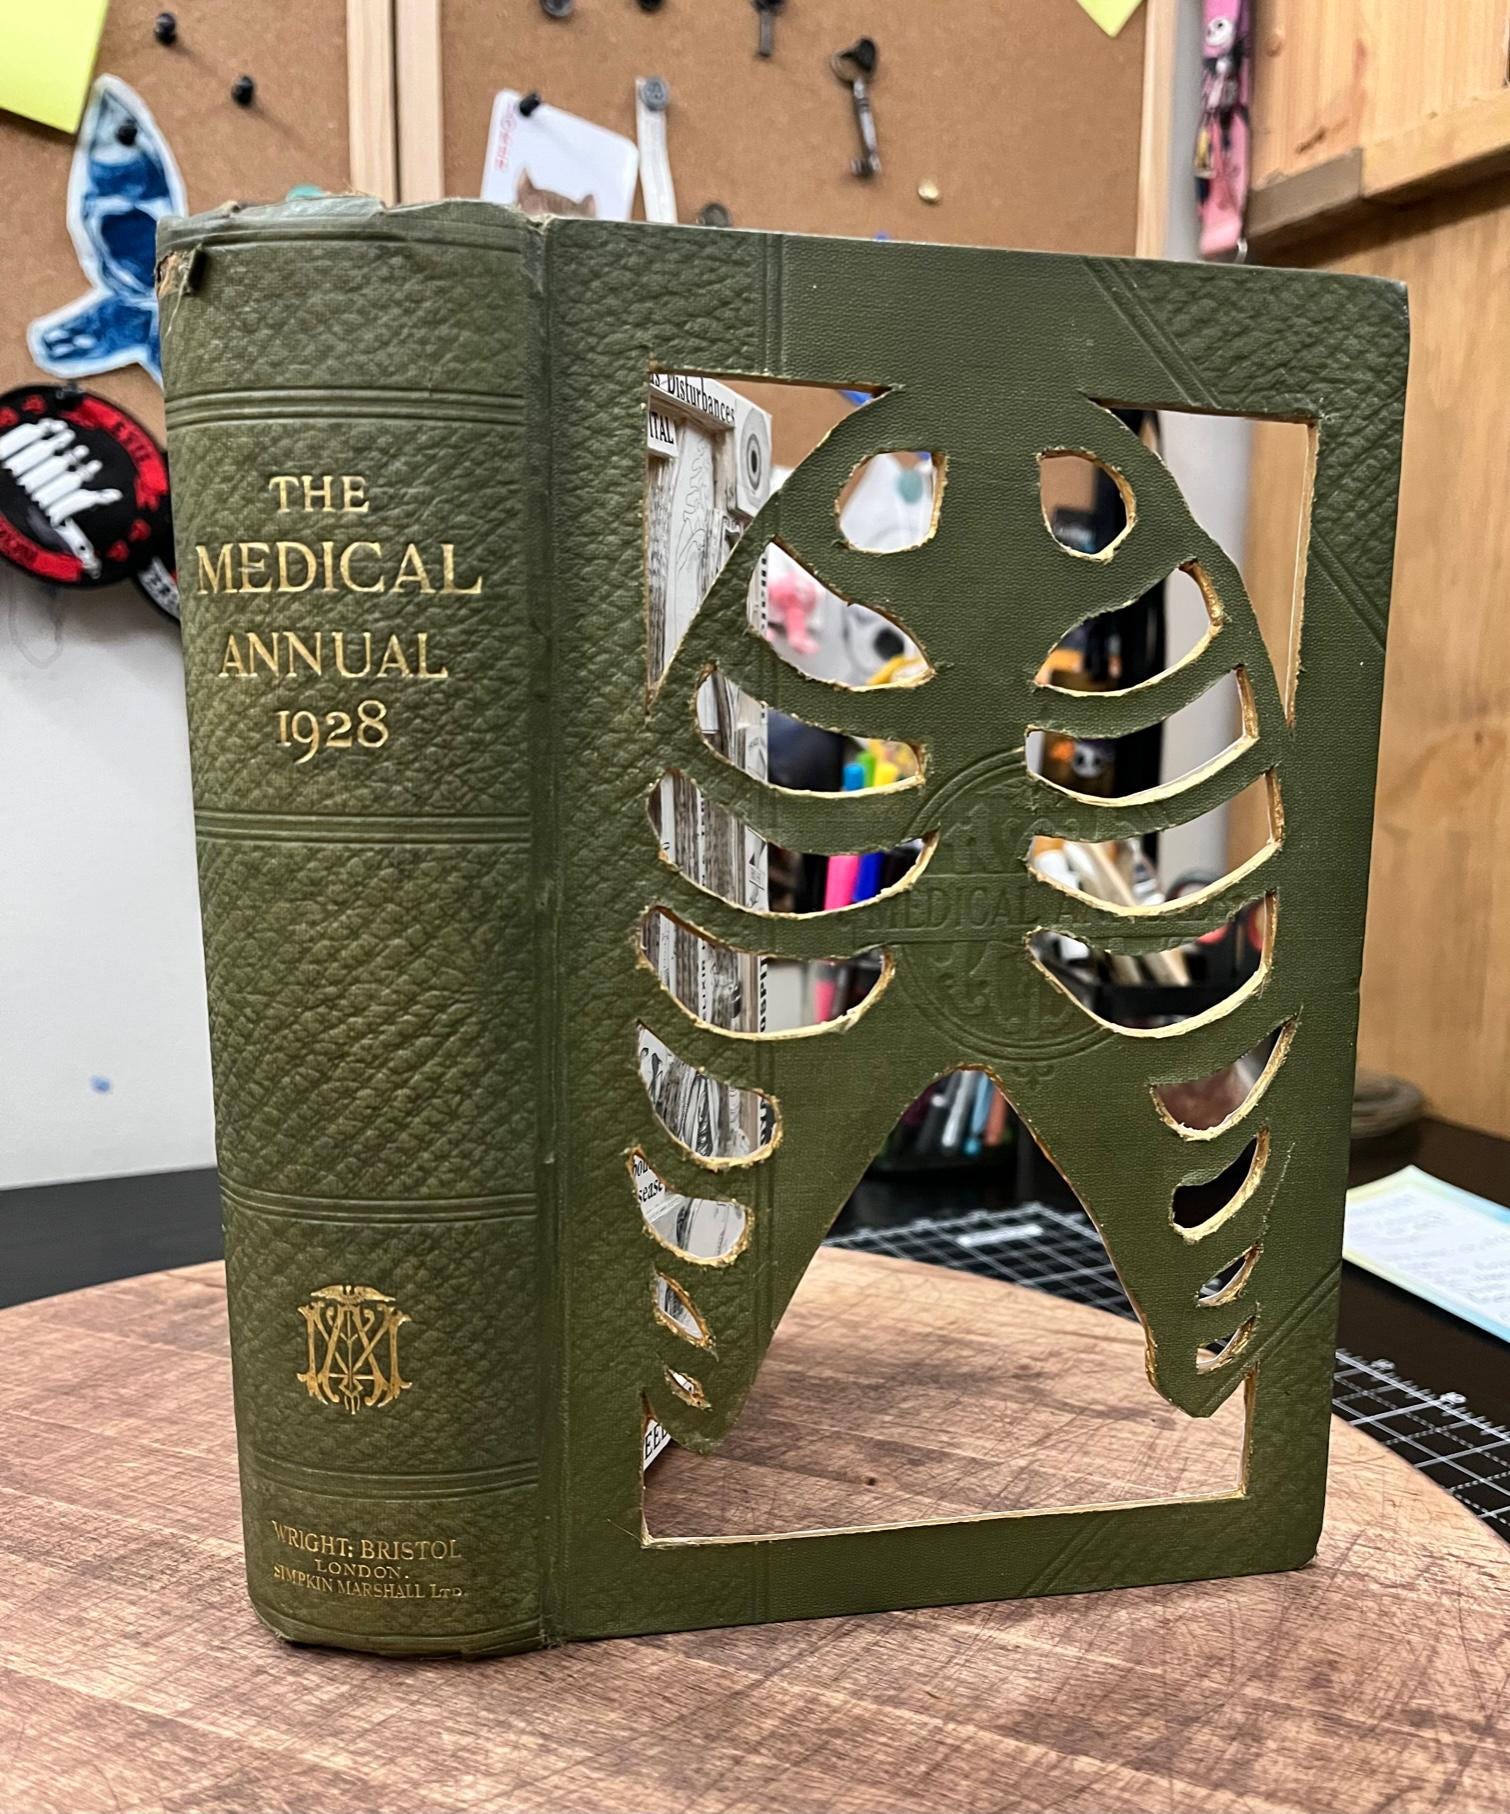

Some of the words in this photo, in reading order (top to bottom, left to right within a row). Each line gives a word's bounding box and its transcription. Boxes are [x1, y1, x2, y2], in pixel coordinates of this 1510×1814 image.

[668, 375, 735, 422] Disturbances
[268, 475, 369, 513] THE
[195, 541, 482, 595] MEDICAL
[218, 632, 448, 678] ANNUAL
[276, 700, 389, 764] 1928
[272, 1520, 353, 1558] WRIGHT:
[361, 1539, 462, 1560] BRISTOL
[273, 1563, 333, 1592] SIMPKIN
[338, 1580, 425, 1598] MARSHALL
[315, 1559, 409, 1579] LONDON.
